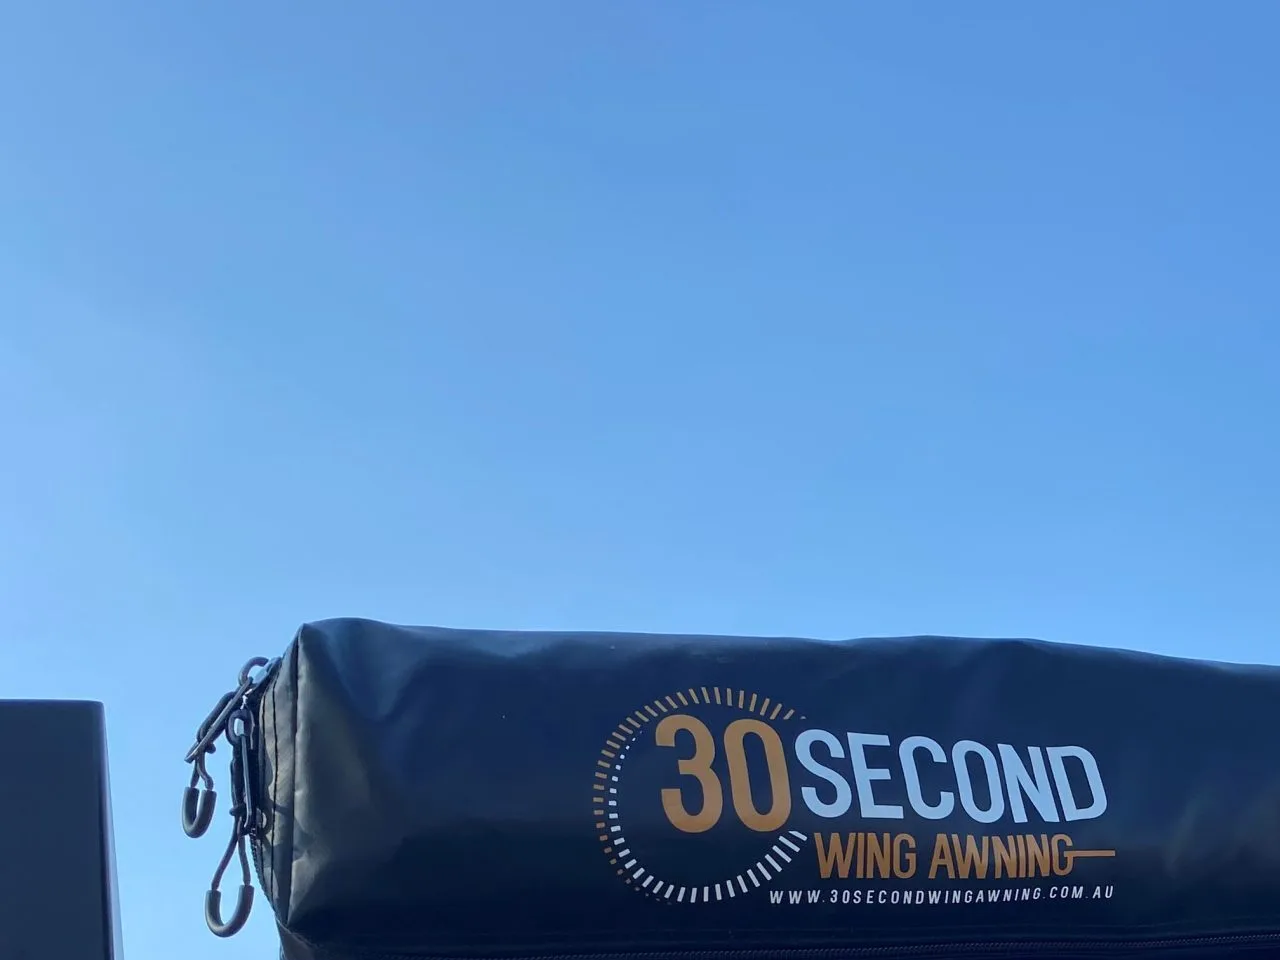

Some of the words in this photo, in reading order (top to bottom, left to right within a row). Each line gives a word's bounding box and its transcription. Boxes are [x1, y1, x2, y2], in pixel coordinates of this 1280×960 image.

[655, 713, 793, 834] 30
[795, 729, 1109, 824] SECOND
[814, 832, 917, 879] WING
[928, 833, 1076, 879] AWNING
